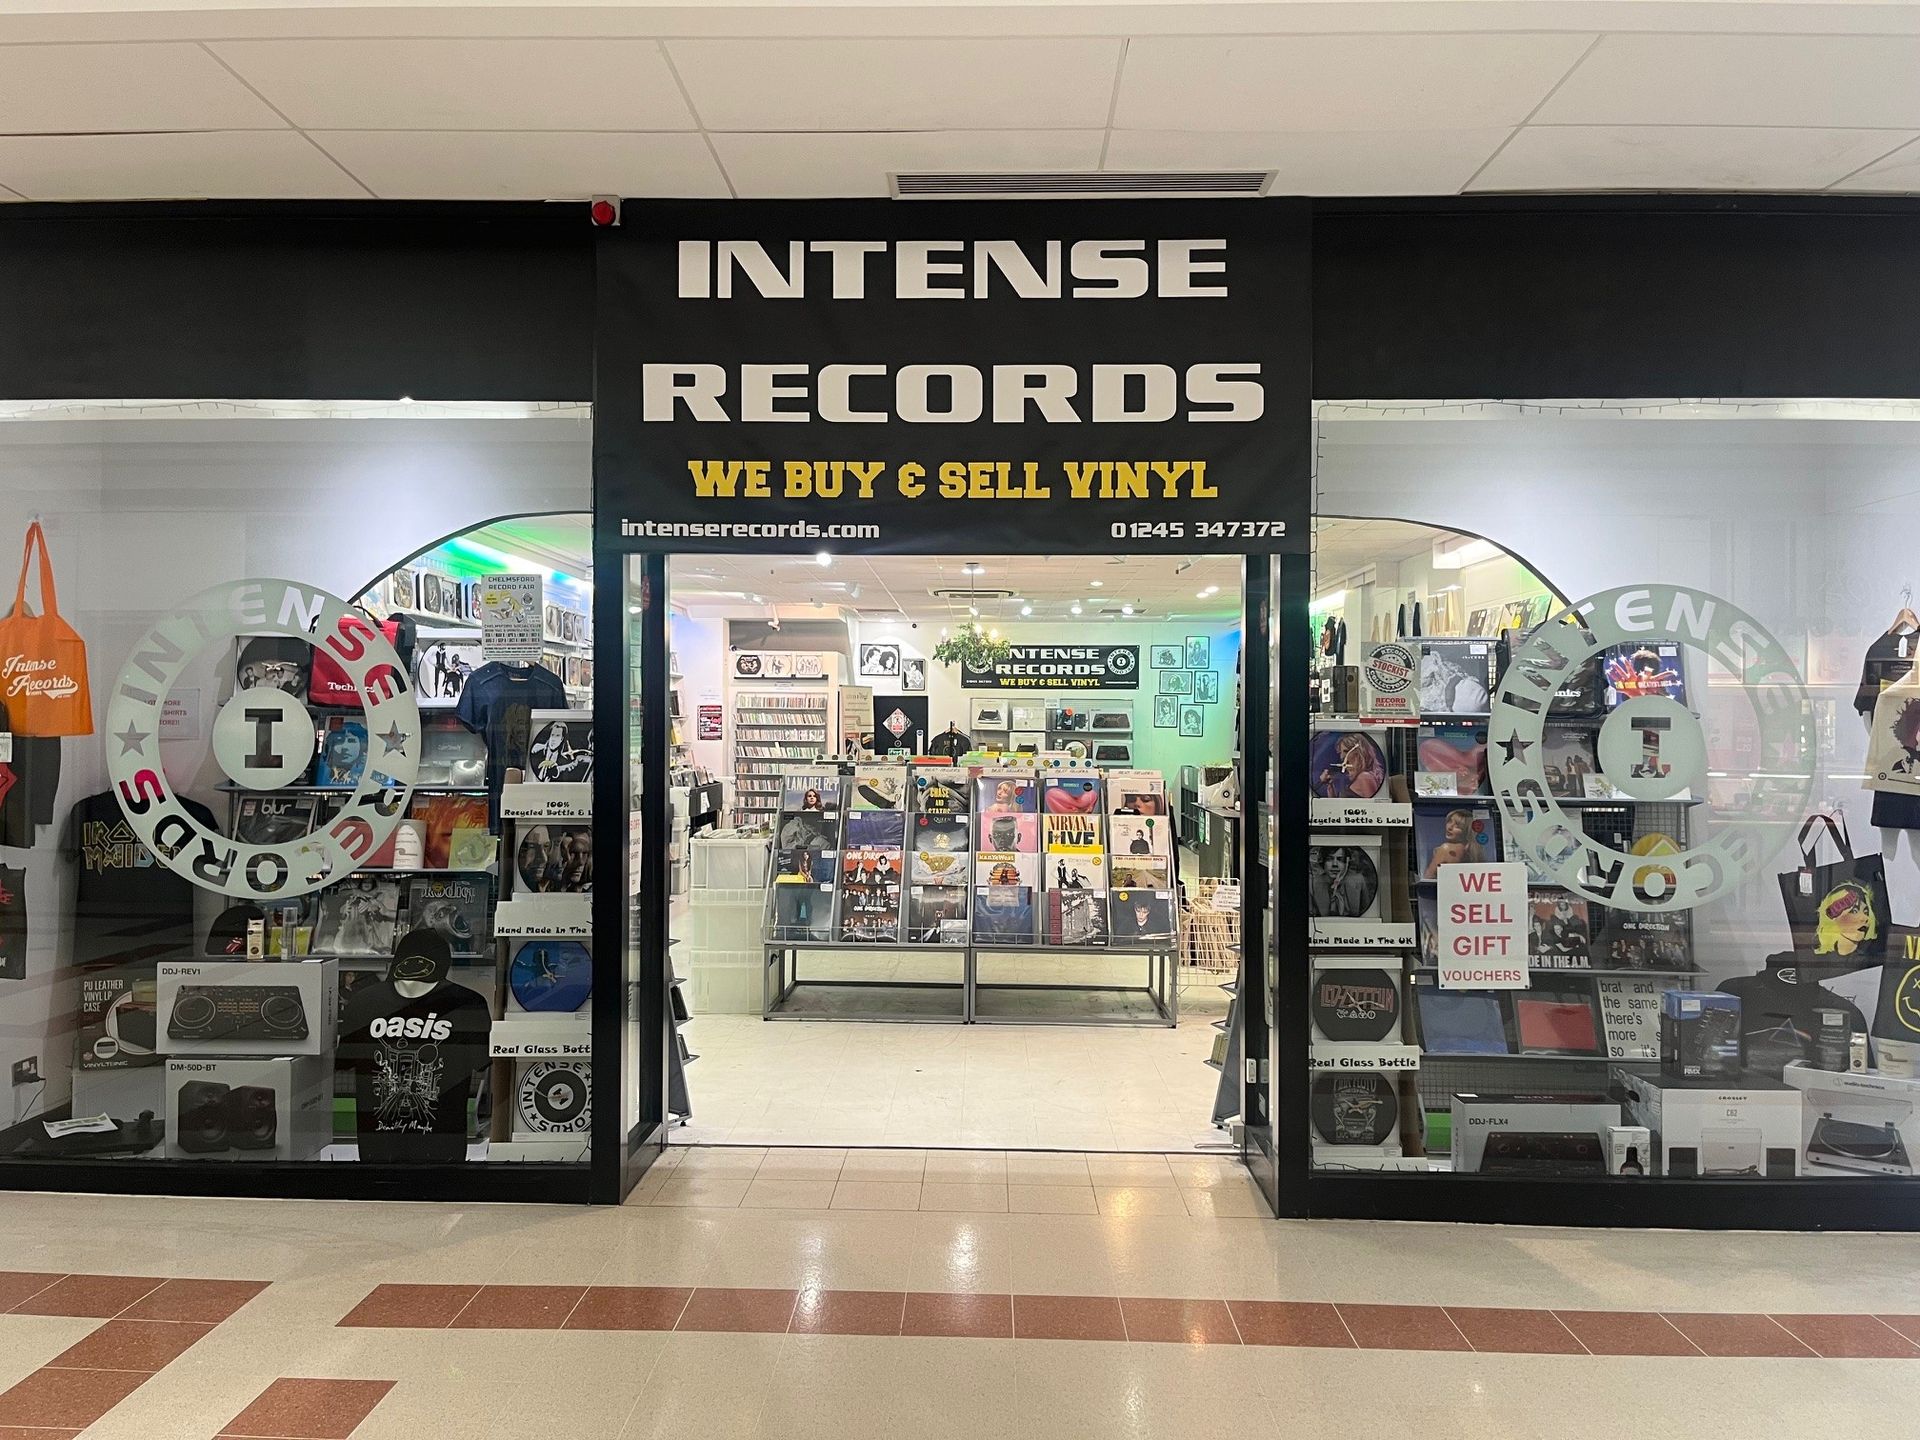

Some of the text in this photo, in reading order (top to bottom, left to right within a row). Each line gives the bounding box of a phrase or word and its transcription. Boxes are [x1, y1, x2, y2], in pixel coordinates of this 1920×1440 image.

[678, 238, 1228, 299] INTENSE
[642, 362, 1265, 423] RECORDS
[688, 460, 772, 497] WE
[784, 460, 887, 498] BUY
[938, 460, 1050, 498] SELL
[1064, 460, 1218, 498] VINYL
[621, 518, 880, 539] intenserecords.com
[1111, 521, 1286, 538] 01245 347372
[120, 584, 408, 707] INTENSE
[1008, 648, 1100, 659] NTENSE
[1381, 648, 1407, 660] RECORD
[1502, 589, 1796, 716] INTENSE
[996, 664, 1106, 675] RECORDS
[1372, 660, 1409, 677] STOCKIST
[999, 678, 1016, 686] WE
[1017, 678, 1037, 686] BUY
[1047, 678, 1069, 686] SELL
[1071, 678, 1101, 686] VINYL
[787, 776, 808, 791] LANA
[808, 776, 822, 791] DEL
[261, 797, 292, 816] blur
[504, 809, 543, 817] Recycled
[1049, 815, 1094, 831] NIRVANA
[1309, 817, 1342, 825] cycled
[83, 820, 141, 851] IRO
[118, 768, 409, 893] RECORDS
[1458, 872, 1502, 893] WE
[1450, 903, 1513, 924] SELL
[497, 926, 522, 934] Hand
[526, 926, 551, 934] Made
[556, 926, 566, 934] In
[569, 926, 587, 934] The
[1452, 936, 1511, 956] GIFT
[1541, 955, 1551, 968] IN
[1553, 955, 1570, 968] THE
[161, 967, 201, 976] DDJ-REV1
[1442, 970, 1522, 982] VOUCHERS
[83, 979, 124, 991] PU LEATHER
[1600, 980, 1654, 993] brat and
[83, 991, 113, 1002] VINYL LP
[1602, 996, 1658, 1010] the same
[83, 1002, 101, 1013] CASE
[1605, 1012, 1643, 1025] there's
[369, 1012, 453, 1040] oasis
[1608, 1030, 1637, 1041] more
[493, 1045, 592, 1054] Real Glass Bott
[1610, 1046, 1624, 1057] so
[170, 1063, 217, 1072] DM-50D-BT
[1339, 1057, 1374, 1067] Glass
[1378, 1057, 1416, 1067] Bottle
[522, 1061, 584, 1110] INTENSE
[1468, 1117, 1509, 1126] DDJ-FLX4
